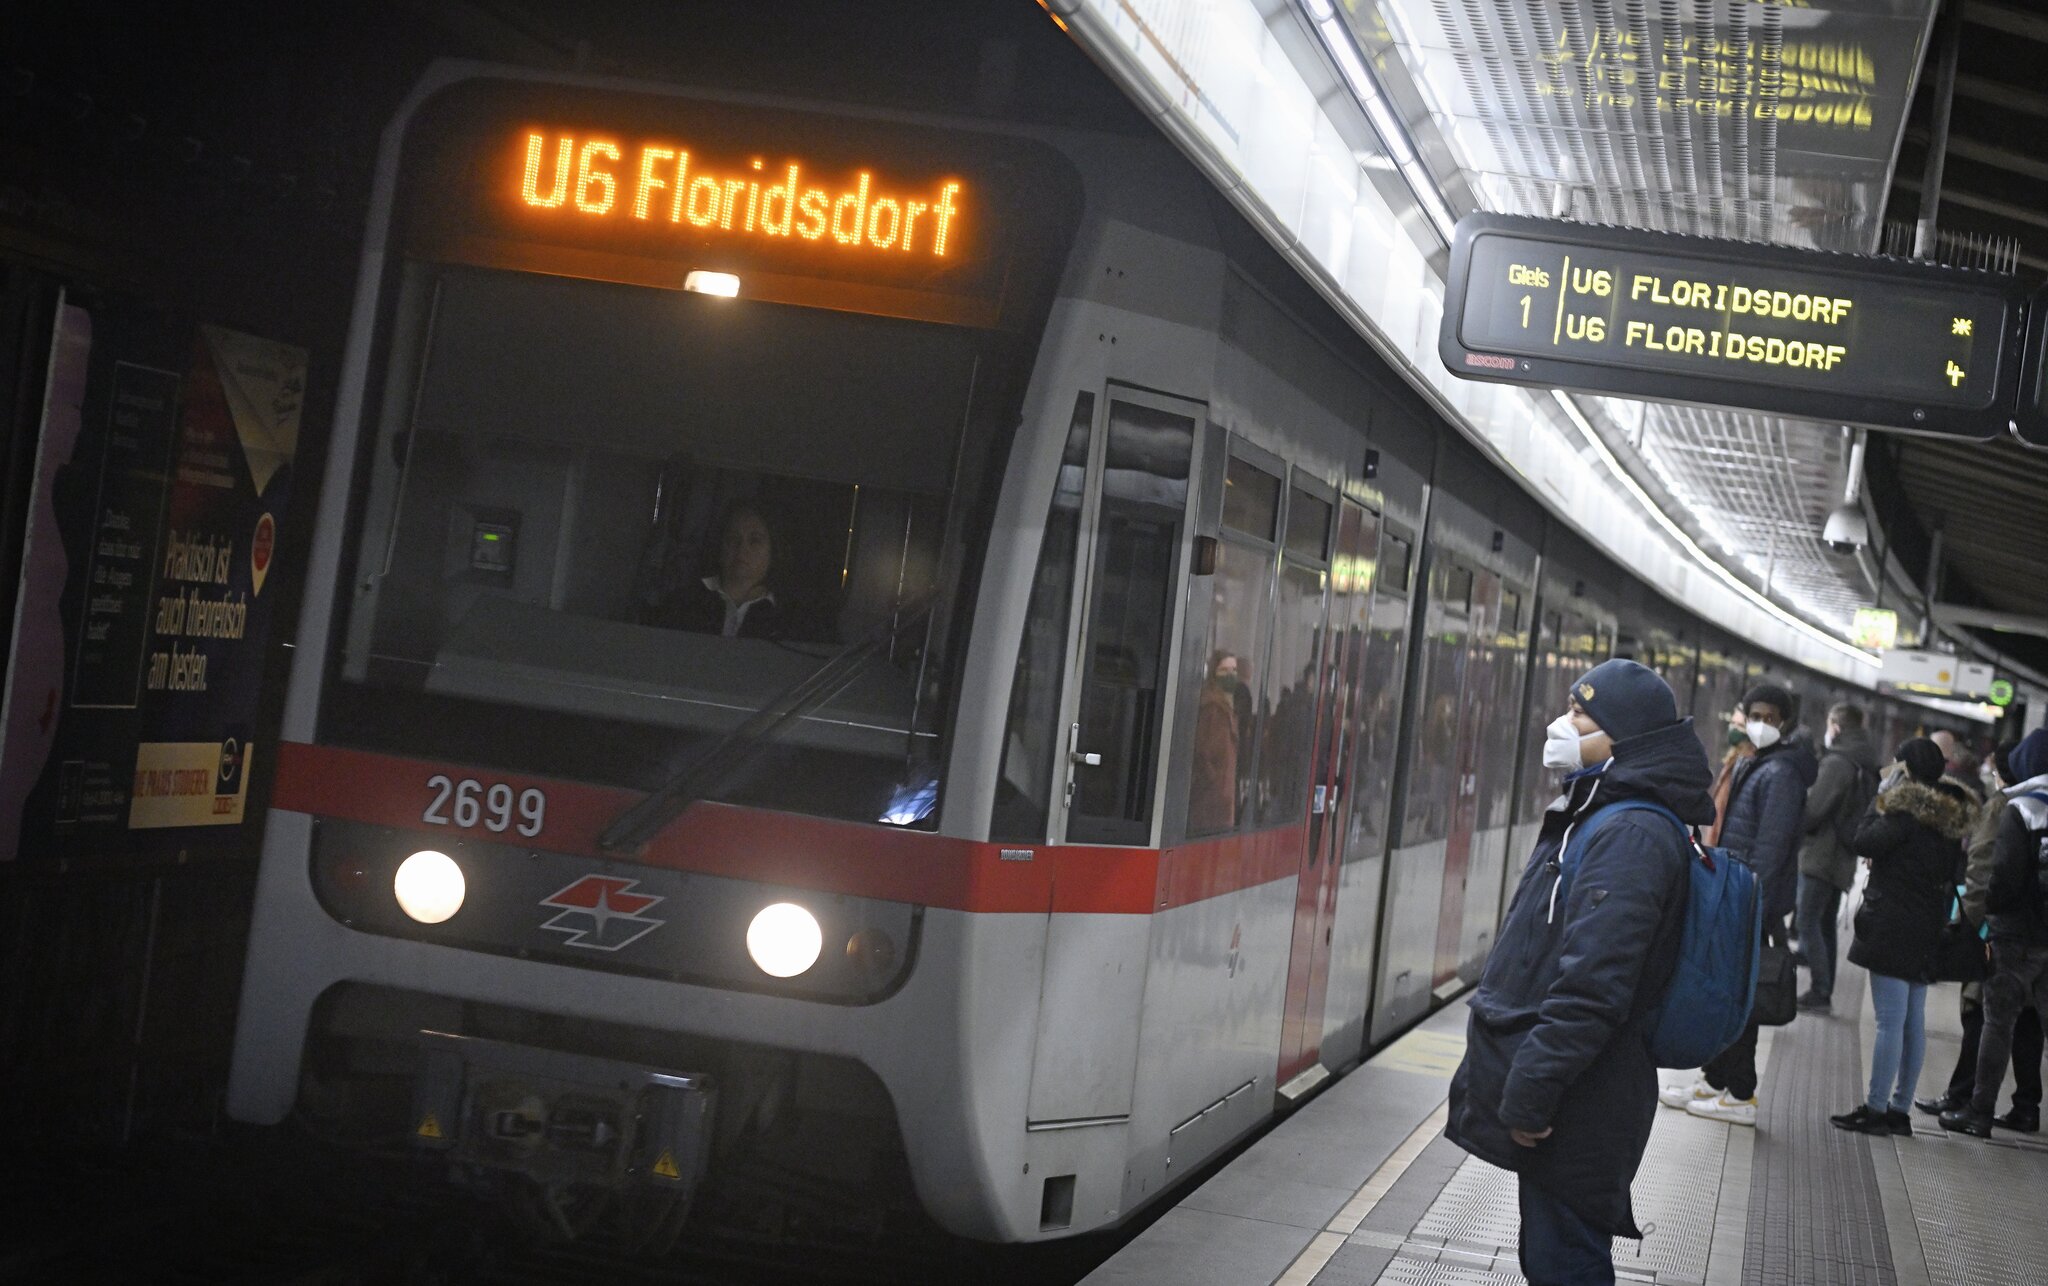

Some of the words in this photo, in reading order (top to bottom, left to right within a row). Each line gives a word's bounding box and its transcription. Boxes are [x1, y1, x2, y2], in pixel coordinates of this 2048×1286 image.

[522, 133, 620, 215] U6
[634, 147, 960, 256] Floridsdorf
[1508, 263, 1550, 288] Gleis
[1572, 267, 1612, 297] U6
[1631, 275, 1852, 324] FLORIDSDORF
[1520, 294, 1532, 329] 1
[1566, 314, 1606, 342] U6
[1625, 320, 1846, 370] FLORIDSDORF
[1946, 360, 1965, 387] 4
[163, 528, 216, 582] Praktisch
[214, 534, 232, 585] ist
[156, 584, 186, 635] auch
[186, 586, 247, 639] theoretisch
[147, 652, 170, 691] am
[168, 640, 208, 692] besten.
[422, 775, 547, 837] 2699
